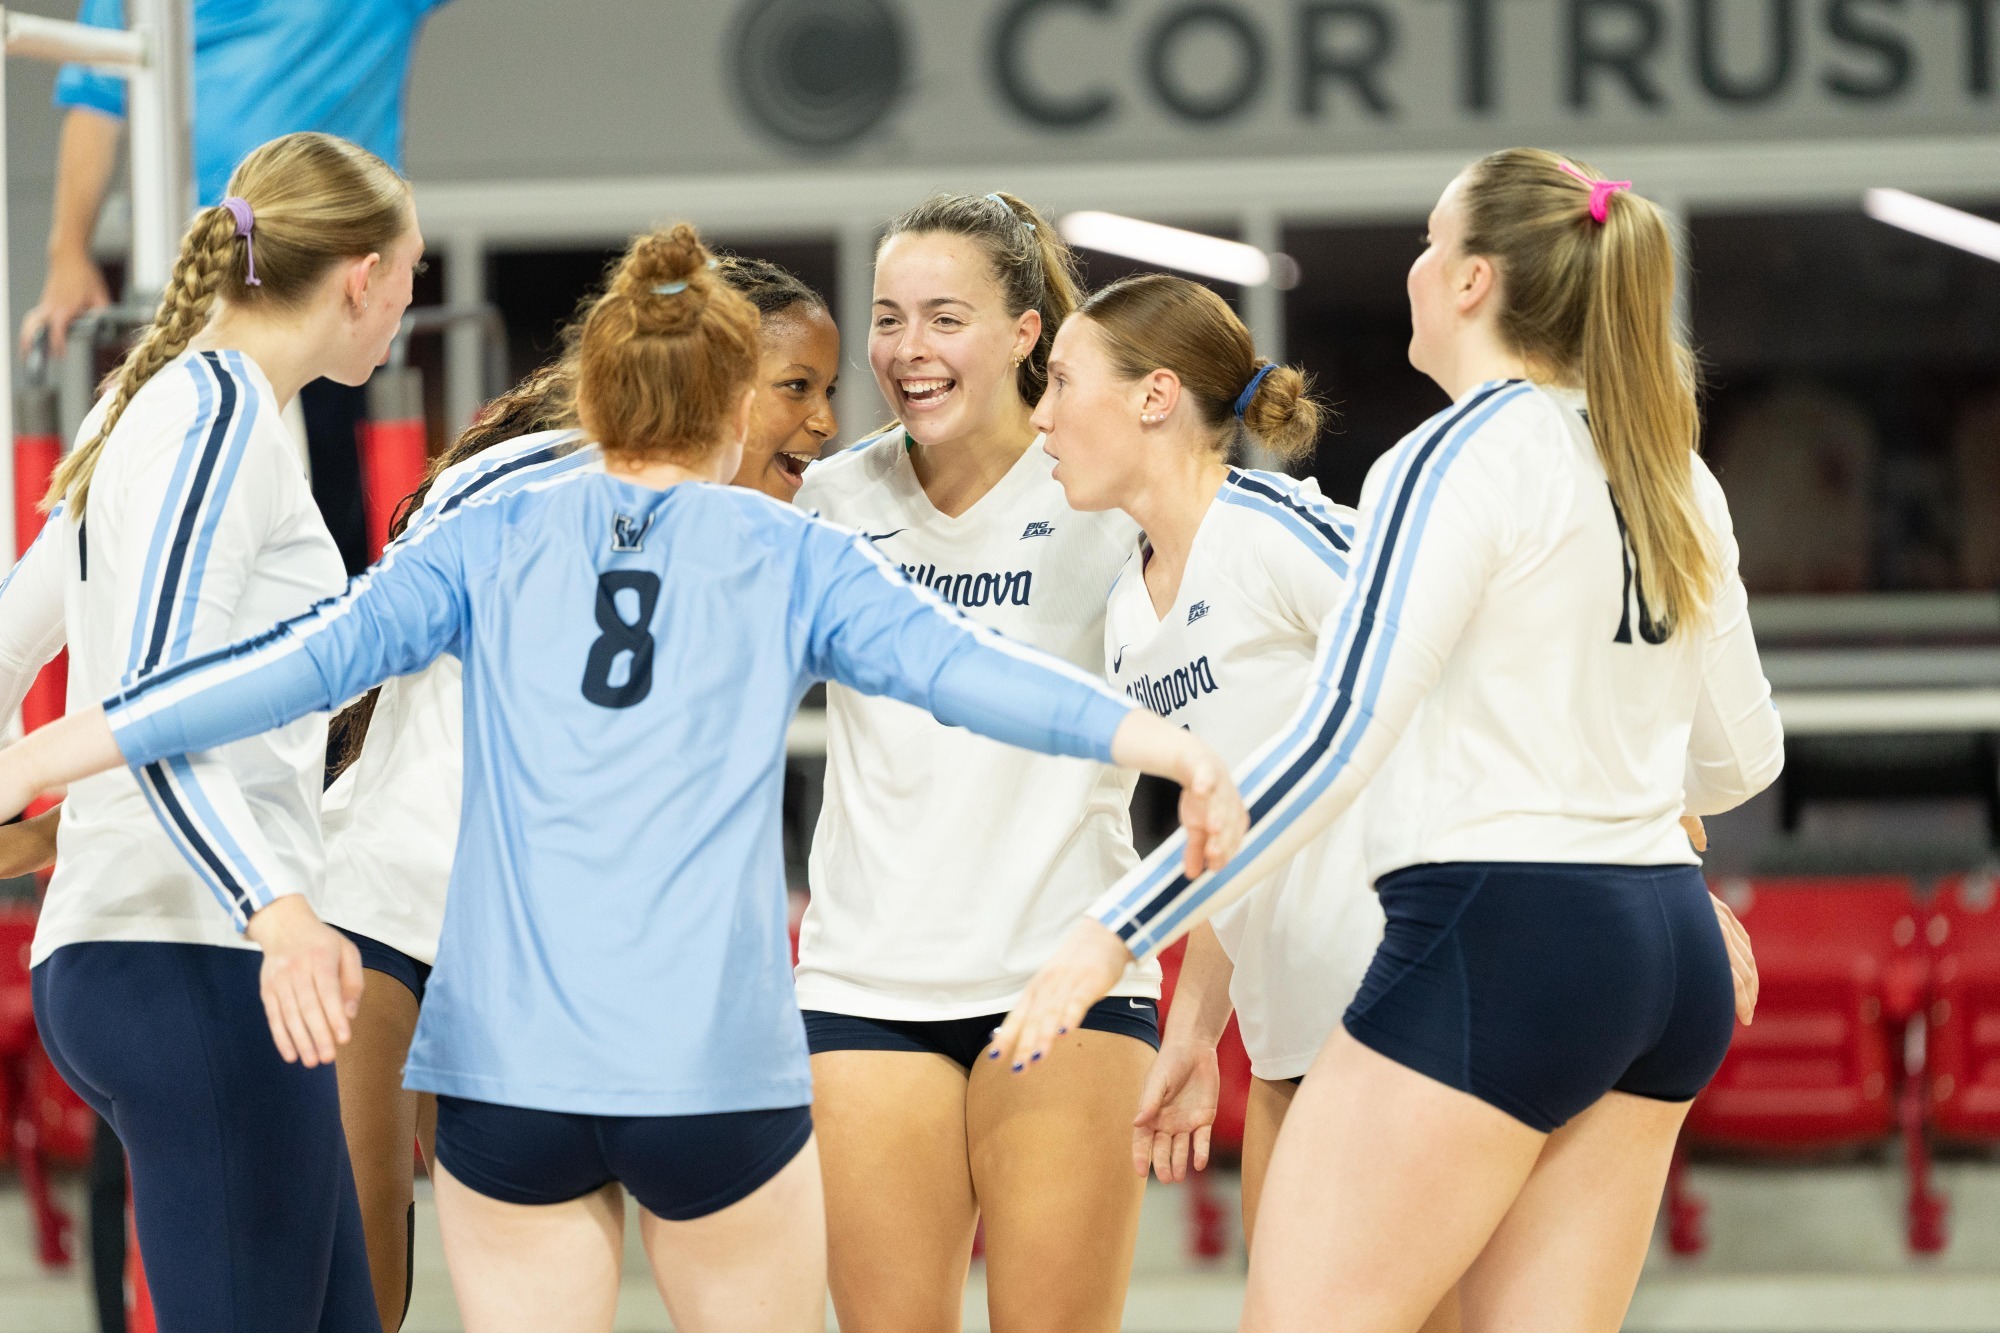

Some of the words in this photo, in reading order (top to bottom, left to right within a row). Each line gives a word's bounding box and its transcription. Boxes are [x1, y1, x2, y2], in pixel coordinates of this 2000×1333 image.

[1026, 520, 1050, 530] BIG
[1022, 527, 1056, 537] EAST
[581, 569, 661, 710] 8
